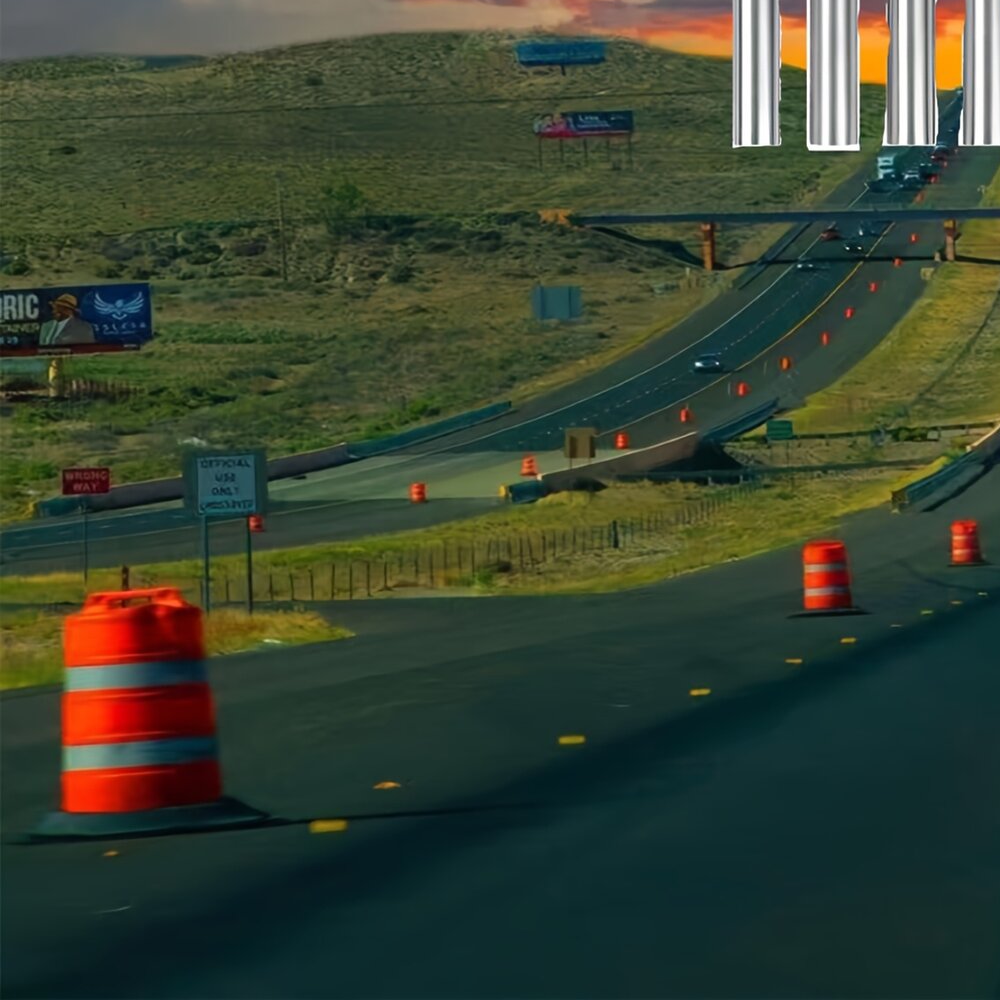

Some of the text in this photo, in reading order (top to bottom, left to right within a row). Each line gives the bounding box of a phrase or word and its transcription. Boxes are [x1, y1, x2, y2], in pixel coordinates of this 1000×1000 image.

[0, 294, 39, 320] RIC
[200, 459, 250, 468] OFFICIAL
[65, 471, 107, 480] WRONG
[72, 482, 96, 491] WAY
